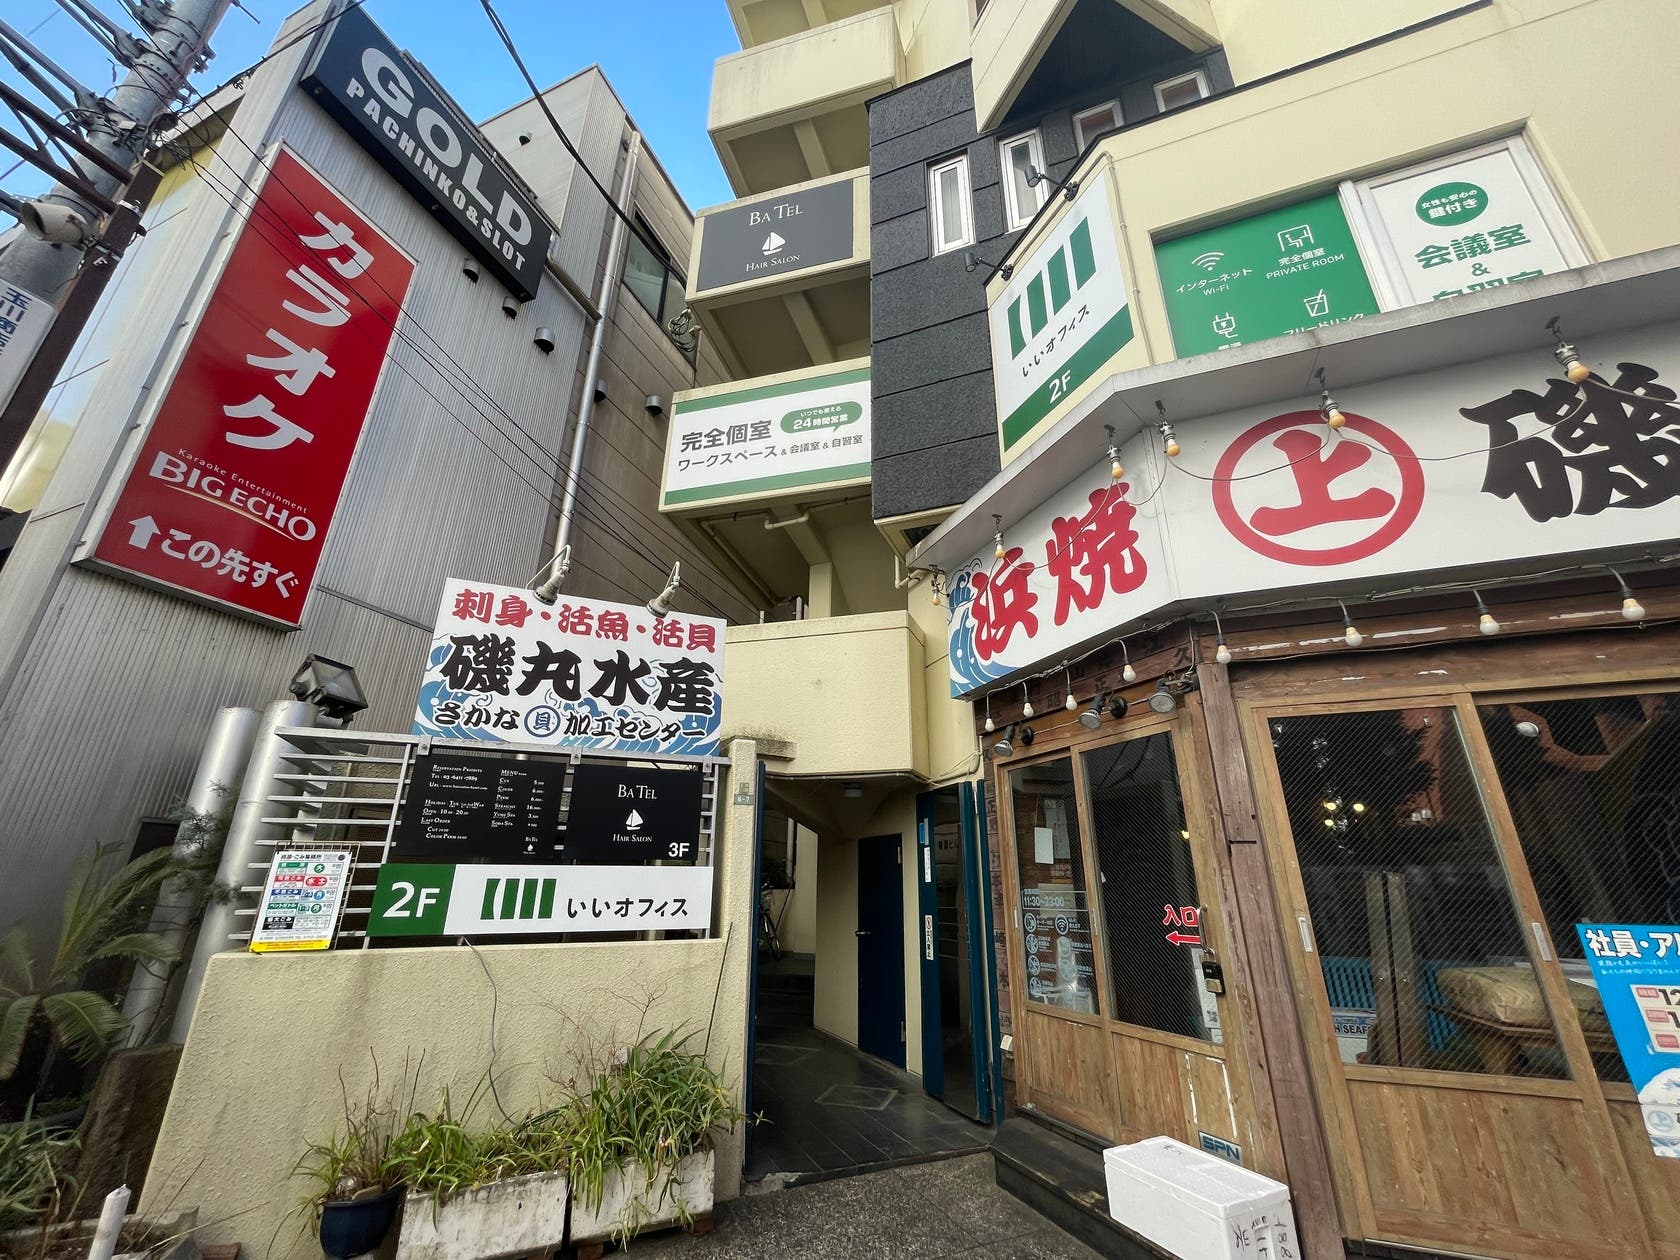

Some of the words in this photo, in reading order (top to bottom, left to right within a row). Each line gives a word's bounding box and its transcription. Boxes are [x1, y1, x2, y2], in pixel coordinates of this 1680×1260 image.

[361, 47, 532, 246] GOLD
[345, 77, 526, 271] PACHINKO&SLOT
[1265, 262, 1310, 280] PRIVATE
[1312, 253, 1345, 269] ROOM
[1414, 223, 1532, 270] 会議室
[1176, 267, 1253, 294] インターネット
[1471, 262, 1491, 277] &
[222, 209, 375, 451] カラオケ
[1021, 304, 1090, 378] いいオフィス
[1049, 369, 1071, 405] 2F
[677, 445, 778, 472] ワークスペース
[790, 441, 820, 454] 会議室
[680, 419, 772, 453] 完全個室
[1459, 362, 1680, 523] 磯
[149, 450, 225, 498] BIG
[229, 487, 317, 541] ECHO
[178, 447, 227, 477] Karaoke
[231, 472, 308, 514] Entertainment
[161, 528, 299, 598] この先すぐ
[970, 481, 1148, 661] 浜焼
[452, 588, 718, 654] 刺身・活魚・活貝
[440, 632, 716, 717] 磯丸水産
[434, 700, 520, 731] さかな
[562, 710, 707, 743] 加工センター
[667, 842, 690, 858] 3F
[382, 880, 441, 919] 2F
[566, 897, 689, 918] いいオフィス
[1162, 903, 1199, 927] 入口
[1342, 1023, 1370, 1035] SEAF
